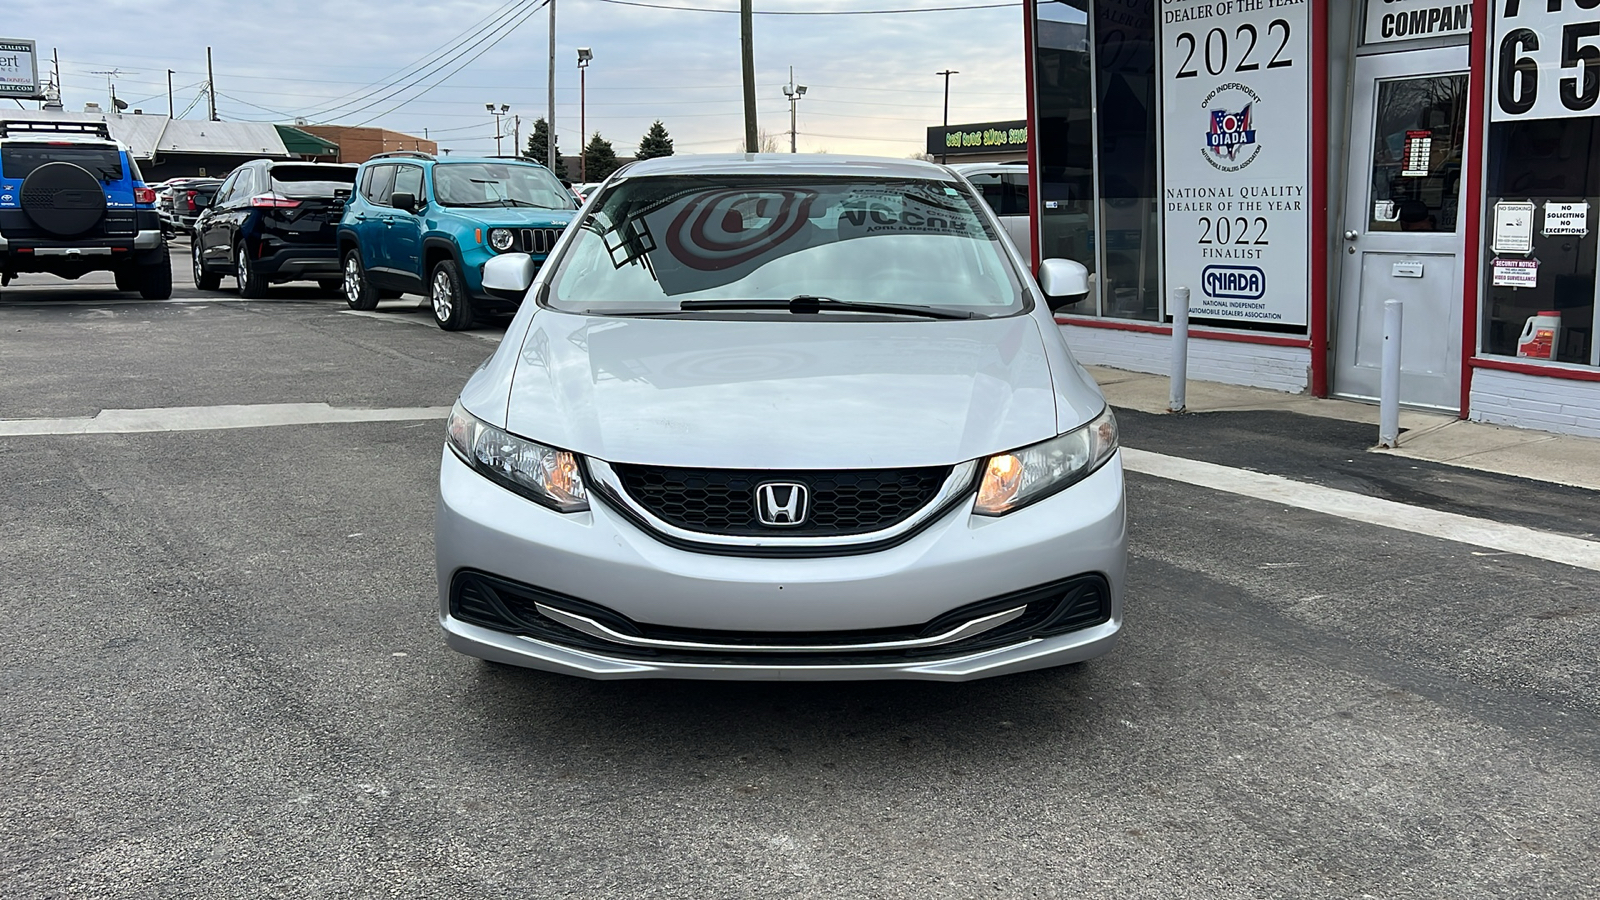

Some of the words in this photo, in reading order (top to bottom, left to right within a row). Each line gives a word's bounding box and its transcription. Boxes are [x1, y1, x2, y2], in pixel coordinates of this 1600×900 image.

[1165, 5, 1213, 24] DEALER
[1216, 1, 1233, 16] OF
[1236, 0, 1263, 12] THE
[1268, 0, 1304, 8] YE
[1176, 18, 1292, 78] 2022
[1201, 90, 1215, 108] OHIO
[1216, 82, 1261, 103] INDEPENDENT
[1212, 132, 1247, 145] OIADA
[1201, 148, 1220, 170] AUTOMOBILE
[1240, 144, 1262, 169] ASSOCIATION
[1167, 188, 1234, 198] NATIONAL
[1240, 186, 1303, 198] QUALITY
[1169, 202, 1213, 211] DEALER
[1218, 202, 1232, 211] OF
[1238, 202, 1262, 210] THE
[1268, 201, 1301, 210] YEAR
[1198, 217, 1269, 245] 2022
[1202, 248, 1262, 259] FINALIST
[1207, 272, 1259, 292] NIADA
[1203, 300, 1228, 308] NATIONAL
[1245, 311, 1281, 319] ASSOCIATION
